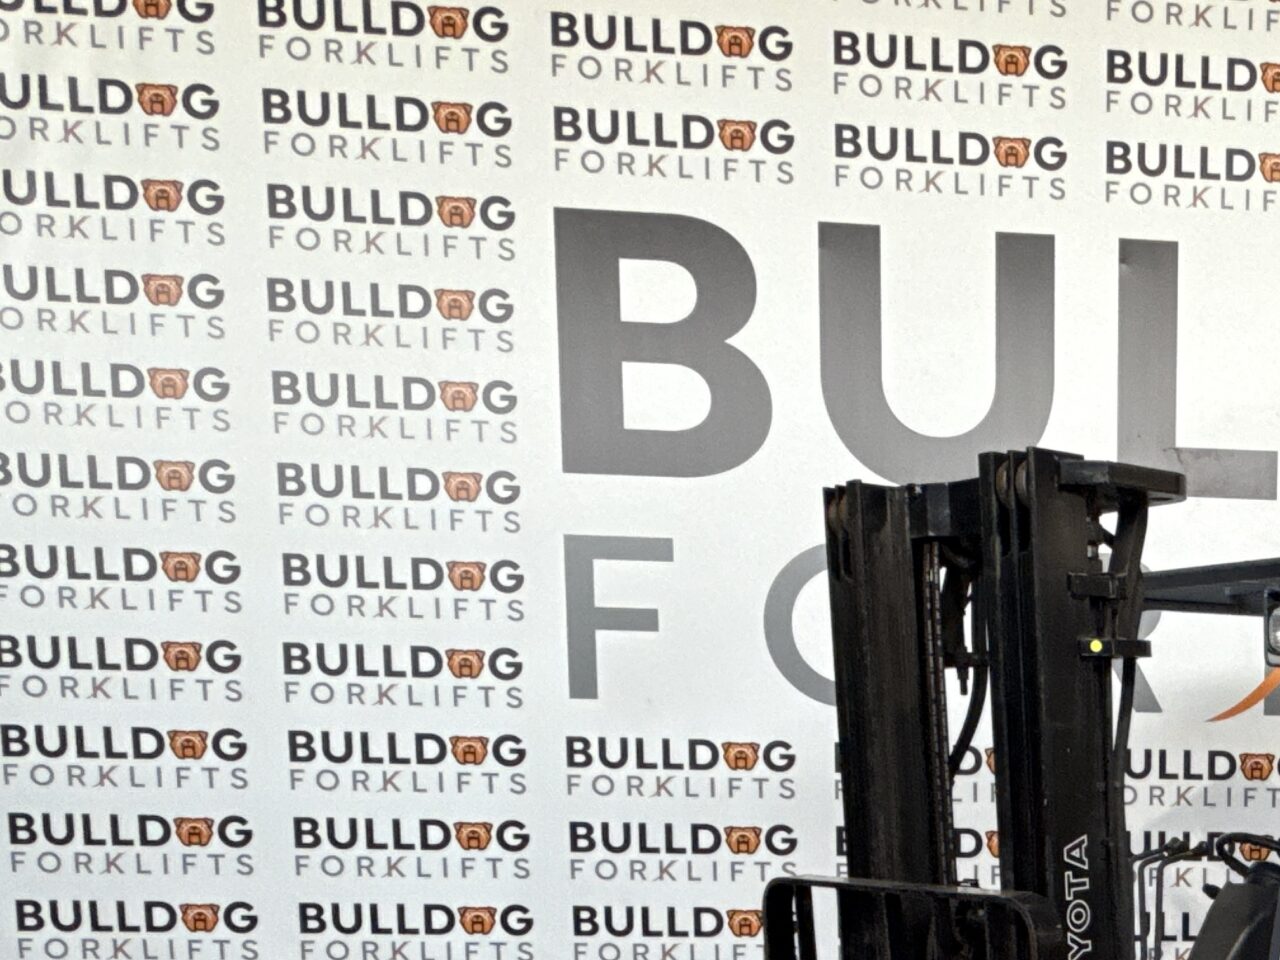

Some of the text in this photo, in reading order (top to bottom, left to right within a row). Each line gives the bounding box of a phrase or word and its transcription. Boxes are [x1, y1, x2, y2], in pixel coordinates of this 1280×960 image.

[257, 0, 509, 43] BULLDG
[550, 11, 793, 62] BULLDG
[259, 34, 508, 74] FORKLIFTS
[833, 30, 1068, 80] BULLDG
[552, 54, 792, 92] FORKLIFTS
[834, 72, 1066, 110] FORKLIFTS
[262, 88, 512, 138] BULLDG
[553, 106, 795, 155] BULLDG
[264, 131, 512, 168] FORKLIFTS
[835, 123, 1067, 171] BULLDG
[555, 148, 794, 184] FORKLIFTS
[835, 165, 1065, 200] FORKLIFTS
[267, 183, 516, 231] BULLDG
[269, 226, 515, 261] FORKLIFTS
[267, 277, 514, 323] BULLDG
[269, 319, 513, 353] FORKLIFTS
[272, 370, 517, 415] BULLDG
[274, 412, 517, 443] FORKLIFTS
[277, 462, 520, 505] BULLDG
[279, 503, 520, 533] FORKLIFTS
[0, 543, 241, 585] BULLDG
[282, 553, 524, 594] BULLDG
[284, 593, 524, 622] FORKLIFTS
[0, 634, 242, 674] BULLDG
[282, 642, 523, 681] BULLDG
[0, 675, 243, 702] FORKLIFTS
[284, 681, 523, 709] FORKLIFTS
[0, 724, 248, 762] BULLDG
[288, 730, 527, 767] BULLDG
[565, 736, 796, 773] BULLDG
[3, 764, 248, 789] FORKLIFTS
[290, 769, 526, 795] FORKLIFTS
[567, 774, 795, 799] FORKLIFTS
[7, 812, 254, 849] BULLDG
[293, 817, 530, 853] BULLDG
[569, 821, 798, 856] BULLDG
[10, 851, 254, 876] FORKLIFTS
[295, 855, 530, 879] FORKLIFTS
[15, 899, 259, 934] BULLDG
[298, 902, 534, 937] BULLDG
[18, 938, 259, 960] FORKLIFTS
